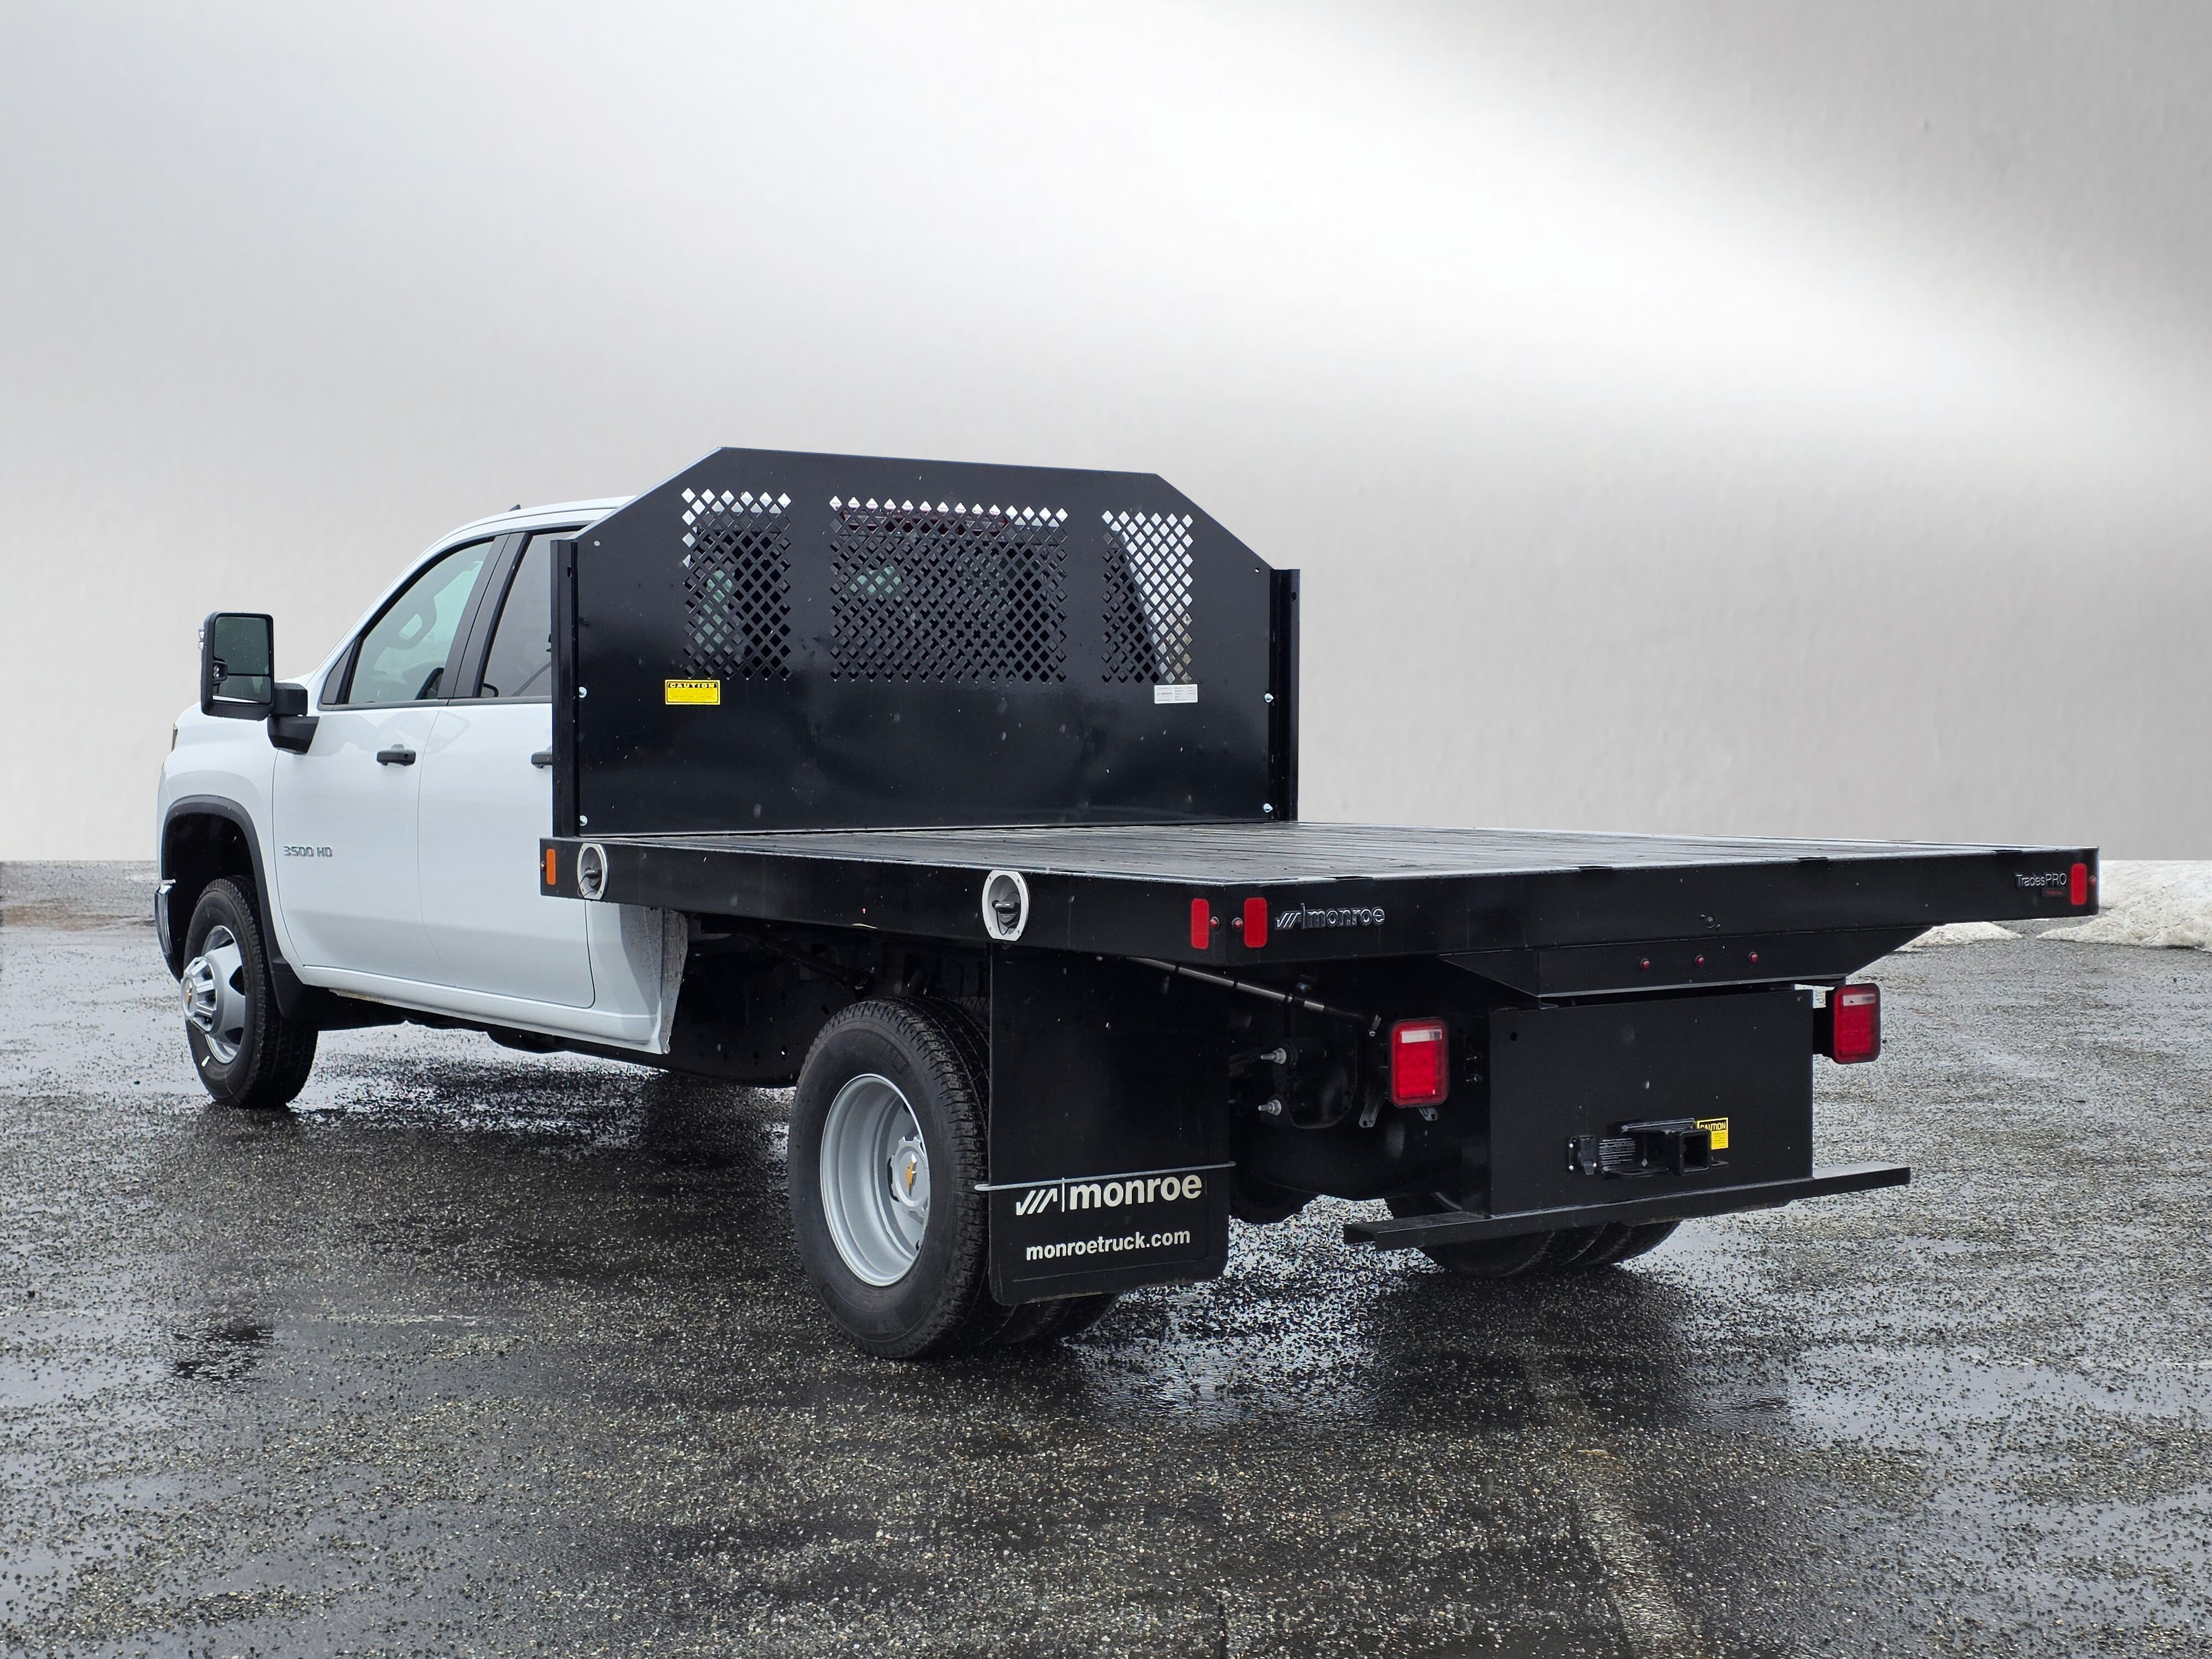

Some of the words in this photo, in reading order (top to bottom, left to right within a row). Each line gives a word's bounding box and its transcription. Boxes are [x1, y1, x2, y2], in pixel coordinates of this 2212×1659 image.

[283, 846, 314, 857] 3500
[317, 847, 333, 857] HD
[2016, 873, 2067, 886] TradesPRO
[1307, 907, 1385, 927] monroe
[1700, 1121, 1726, 1131] CAUTION
[1070, 1173, 1202, 1211] monroe
[1026, 1230, 1191, 1261] monroetruck.com
